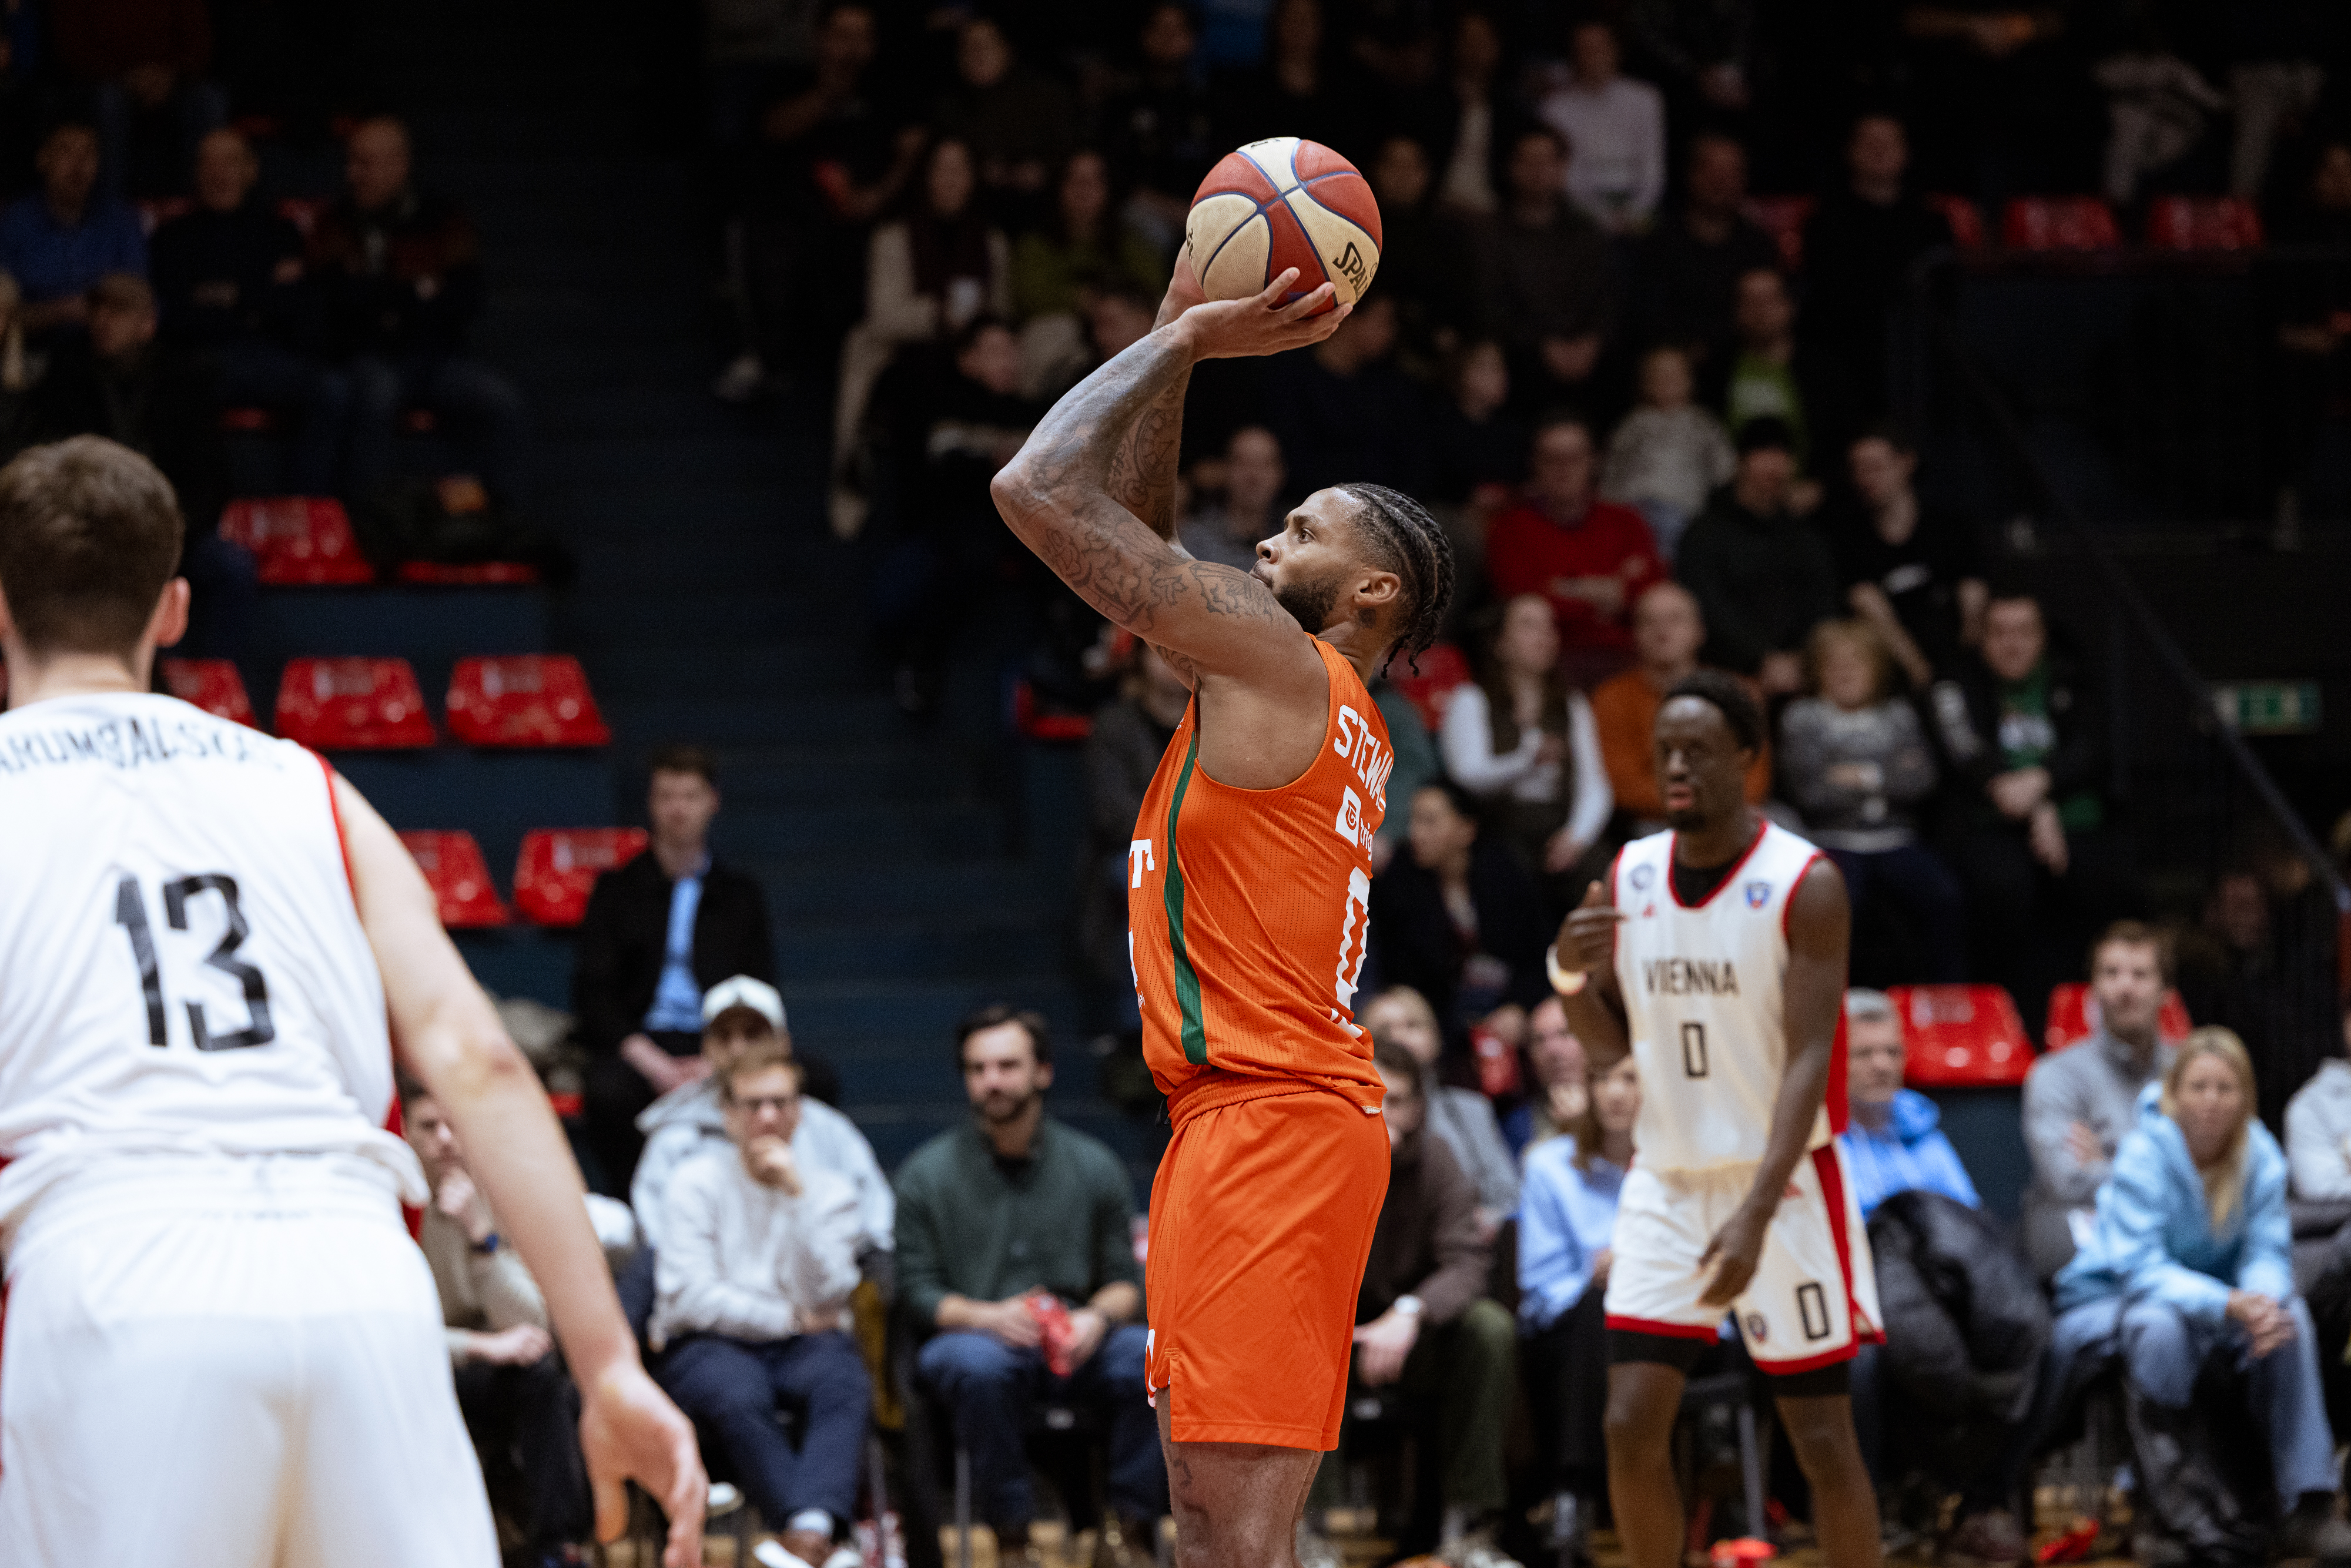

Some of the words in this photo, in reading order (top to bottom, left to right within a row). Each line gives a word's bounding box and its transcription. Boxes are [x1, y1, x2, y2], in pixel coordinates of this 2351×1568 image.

[1332, 242, 1368, 301] SPAL
[1359, 817, 1375, 862] trig
[113, 872, 275, 1052] 13
[1642, 956, 1740, 995] VIENNA
[1681, 1021, 1708, 1078] 0
[1796, 1281, 1830, 1341] 0
